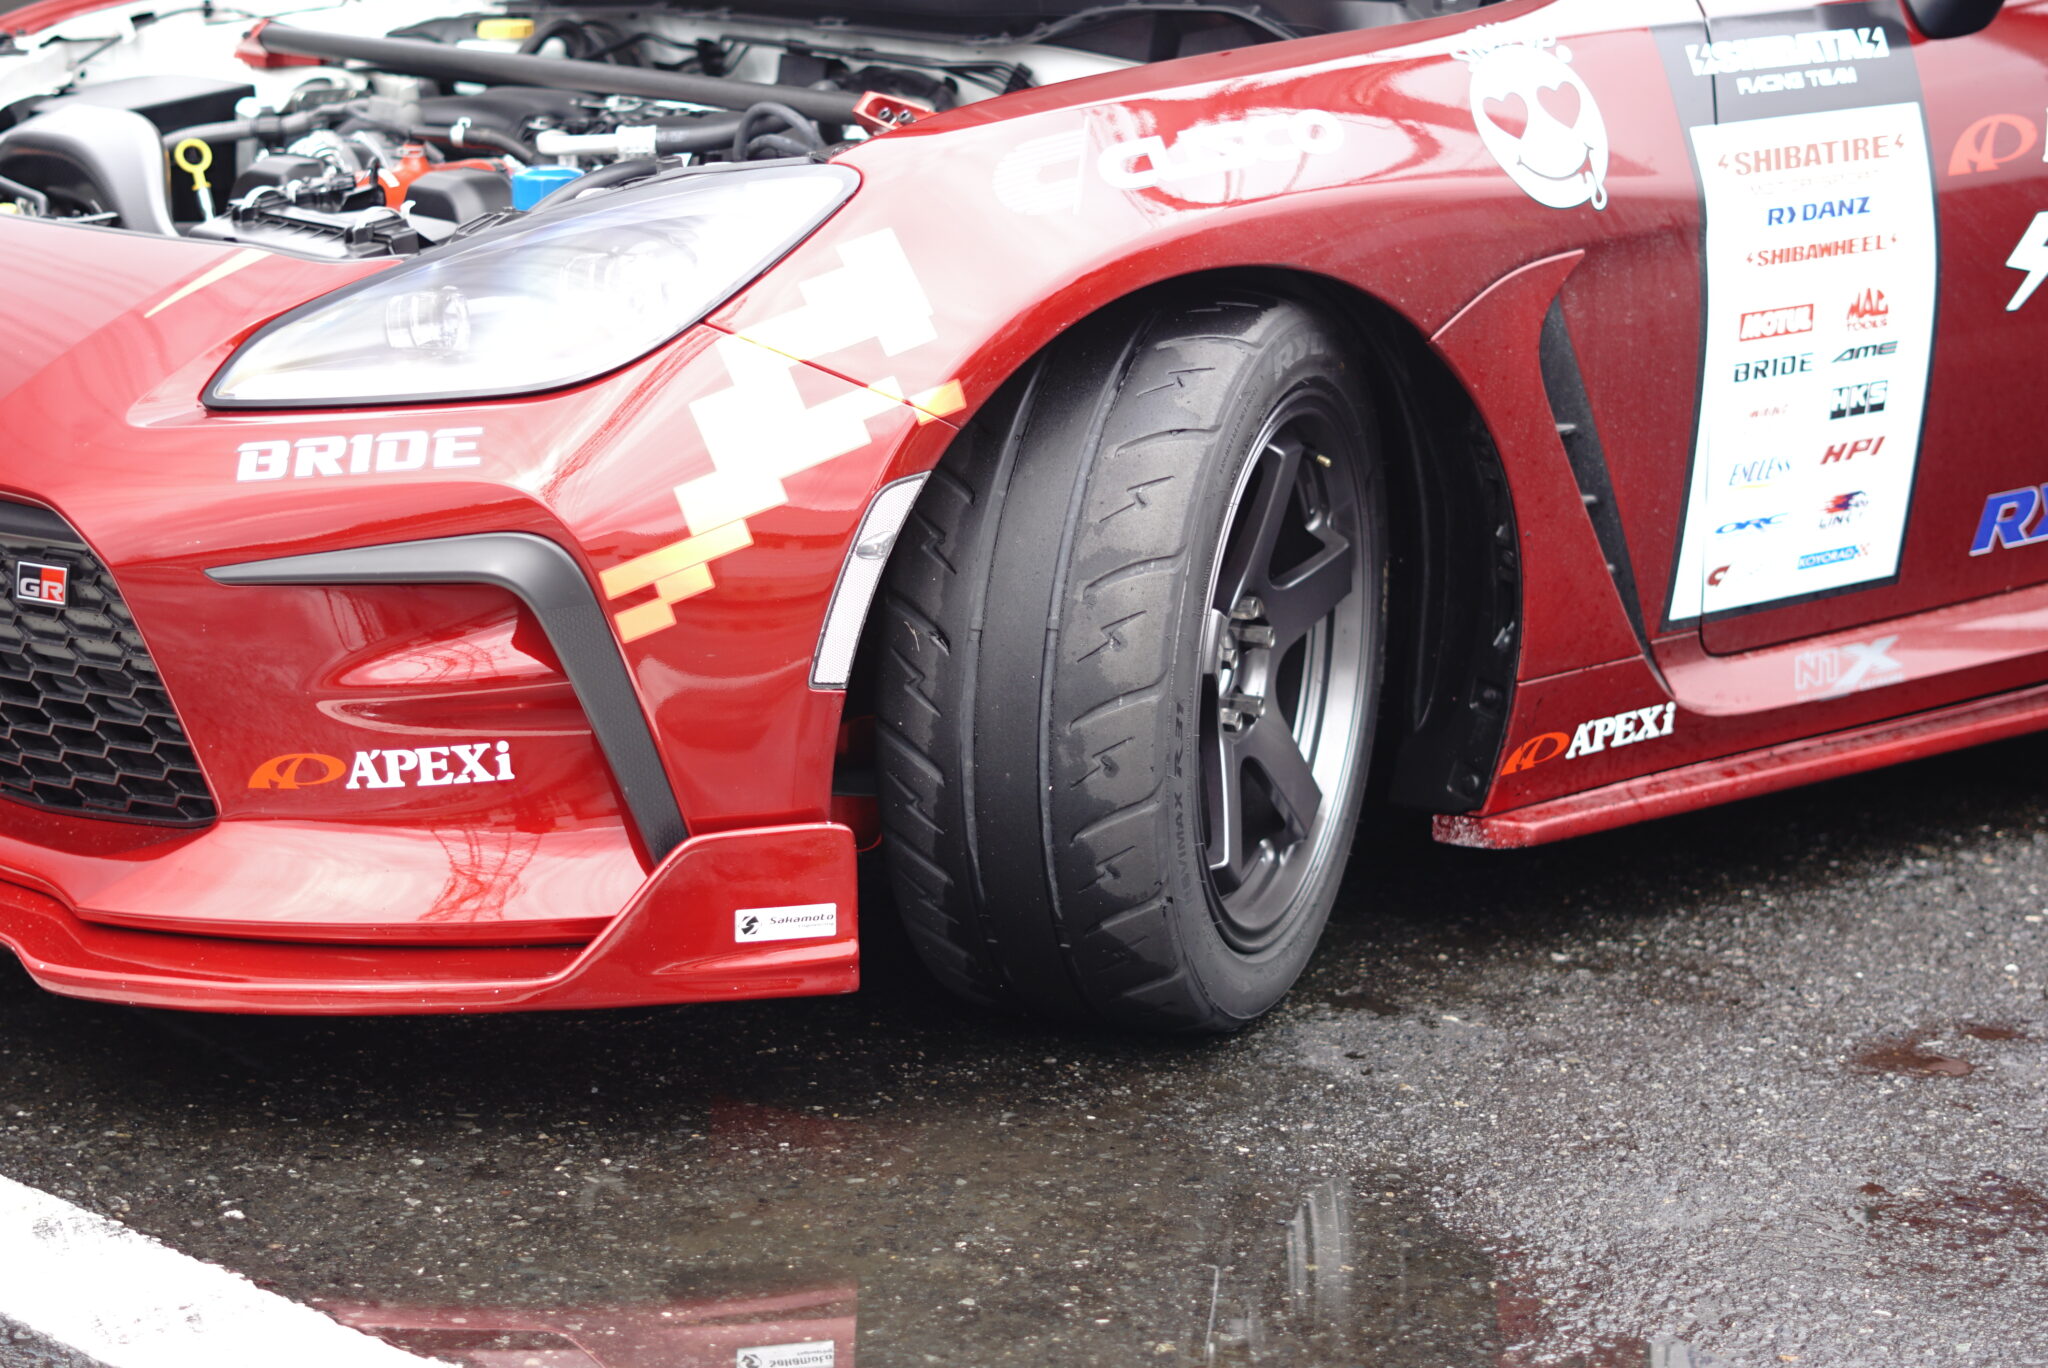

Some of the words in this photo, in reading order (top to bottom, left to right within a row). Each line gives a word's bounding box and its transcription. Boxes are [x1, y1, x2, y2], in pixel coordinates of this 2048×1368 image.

[1736, 71, 1805, 96] RACING
[1805, 66, 1858, 88] TEAM
[1734, 135, 1890, 176] SHIBATIRE
[1757, 234, 1887, 266] SHIBAWHEEL
[1741, 305, 1813, 341] MOTUL
[1734, 352, 1814, 383] BRIDE
[1830, 380, 1888, 418] HKS
[236, 427, 484, 482] BRIDE
[1820, 436, 1885, 465] HPI
[20, 577, 64, 601] GR
[770, 913, 834, 925] Sakamoto
